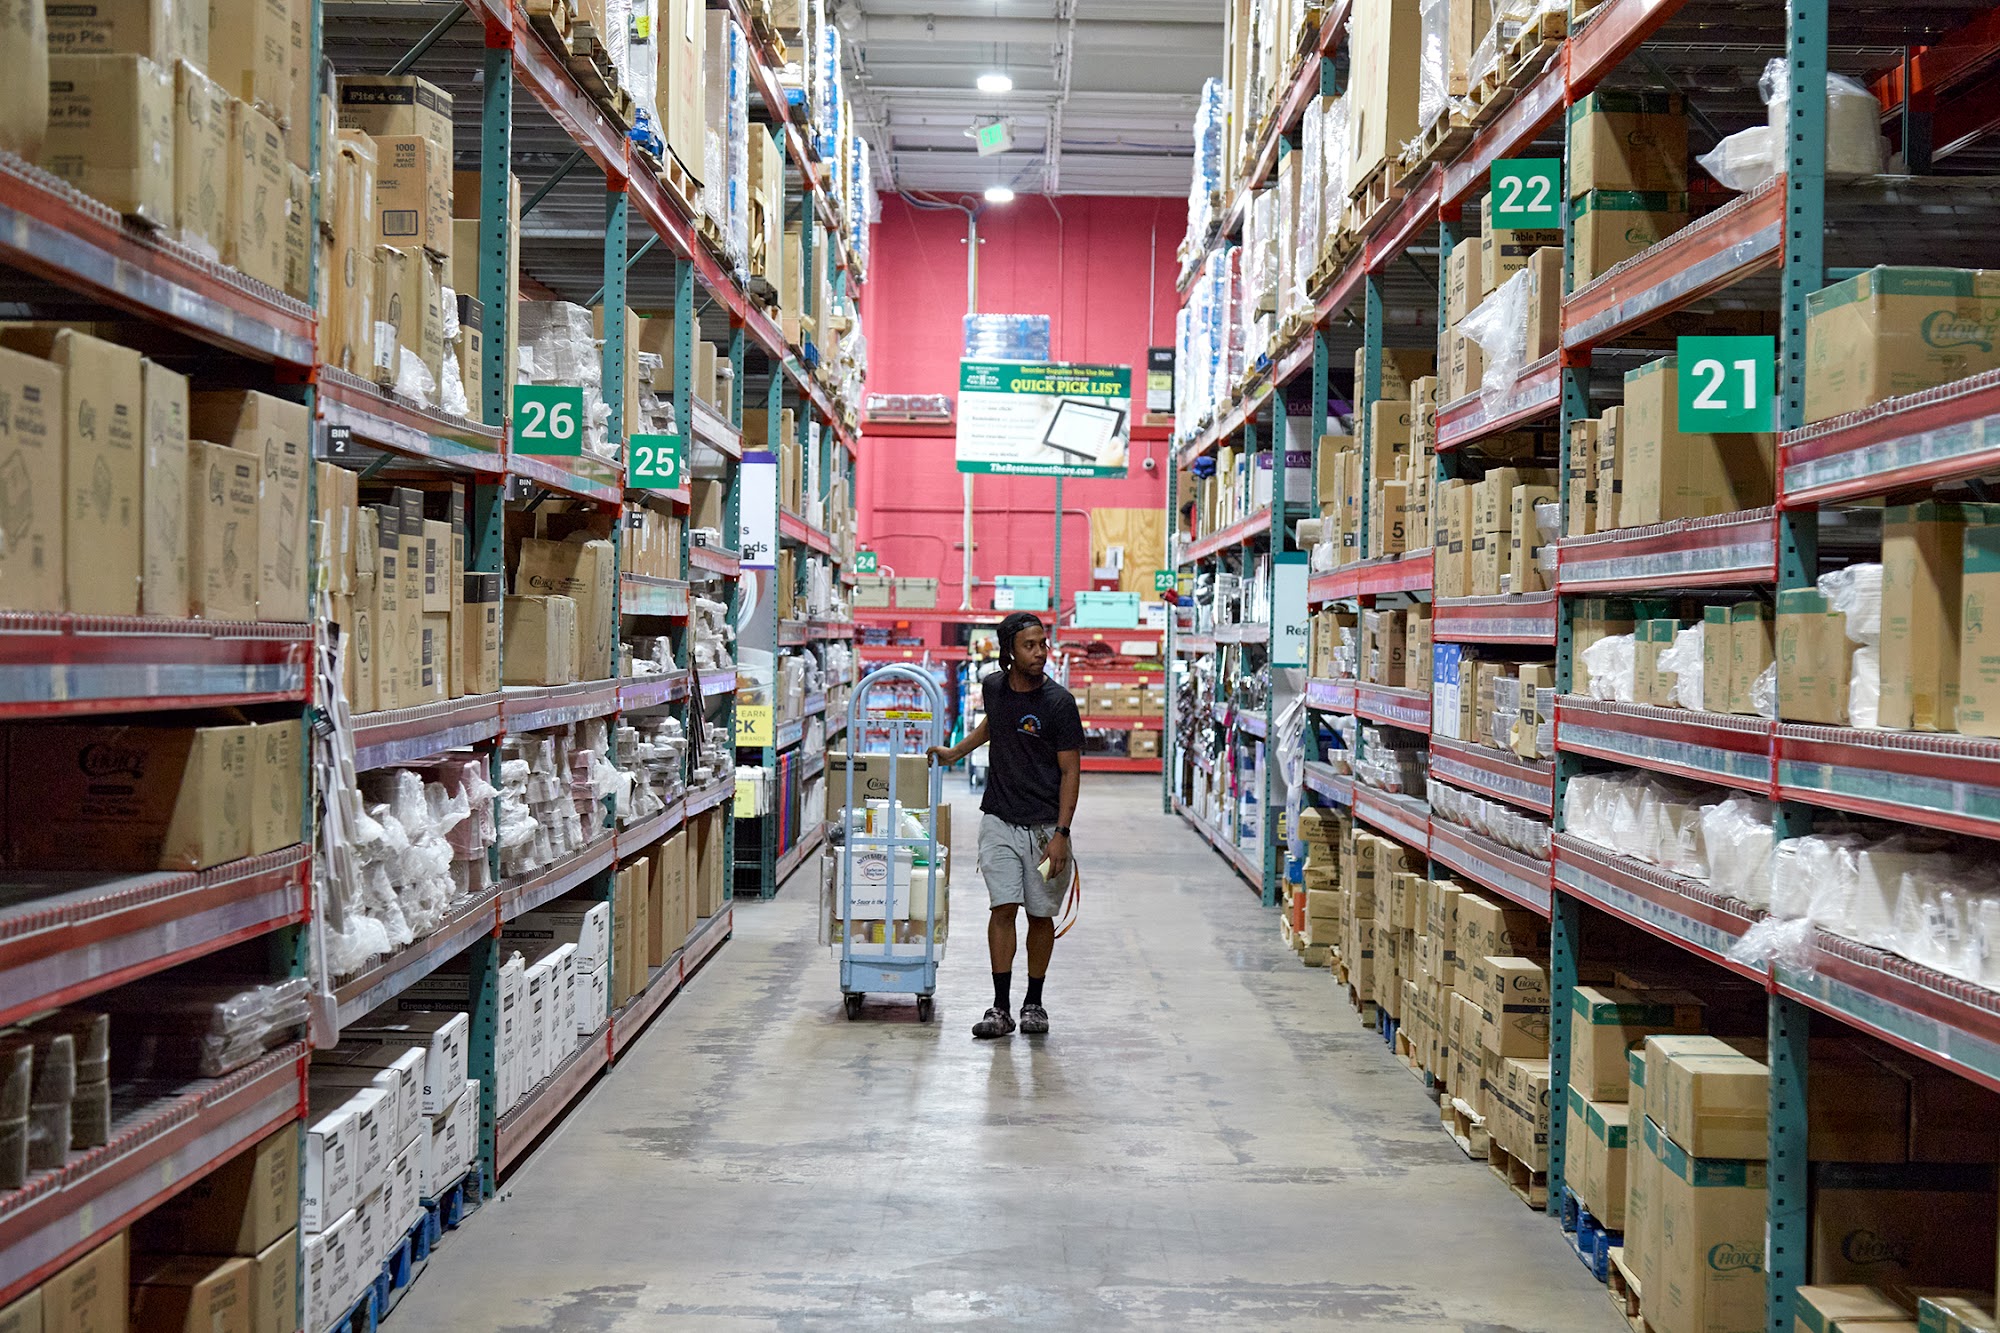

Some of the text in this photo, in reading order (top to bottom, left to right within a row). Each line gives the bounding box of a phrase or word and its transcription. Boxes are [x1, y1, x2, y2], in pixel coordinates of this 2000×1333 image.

[48, 30, 105, 44] eep Pie
[350, 91, 406, 101] Fits 4 oz.
[394, 143, 416, 152] 1000
[1498, 175, 1552, 213] 22
[1510, 232, 1558, 242] Table Pans
[1921, 310, 1995, 353] CHOICE
[1010, 378, 1122, 396] QUICK PICK LIST
[1691, 358, 1757, 409] 21
[521, 401, 575, 440] 26
[331, 428, 350, 438] BIN
[335, 440, 345, 453] 2
[634, 446, 675, 477] 25
[990, 462, 1095, 477] TheRestaurantStore.com
[518, 478, 532, 487] BIN
[522, 487, 528, 496] 1
[631, 512, 643, 520] BIN
[1391, 521, 1405, 539] 5
[857, 555, 875, 569] 24
[529, 574, 553, 591] CHOICE
[1156, 573, 1174, 588] 23
[1392, 647, 1402, 660] 5
[741, 710, 766, 718] EARN
[533, 930, 553, 938] White
[1513, 975, 1543, 992] CHOICE
[1523, 996, 1550, 1004] Foil Ste
[1708, 1242, 1765, 1273] CHOICE
